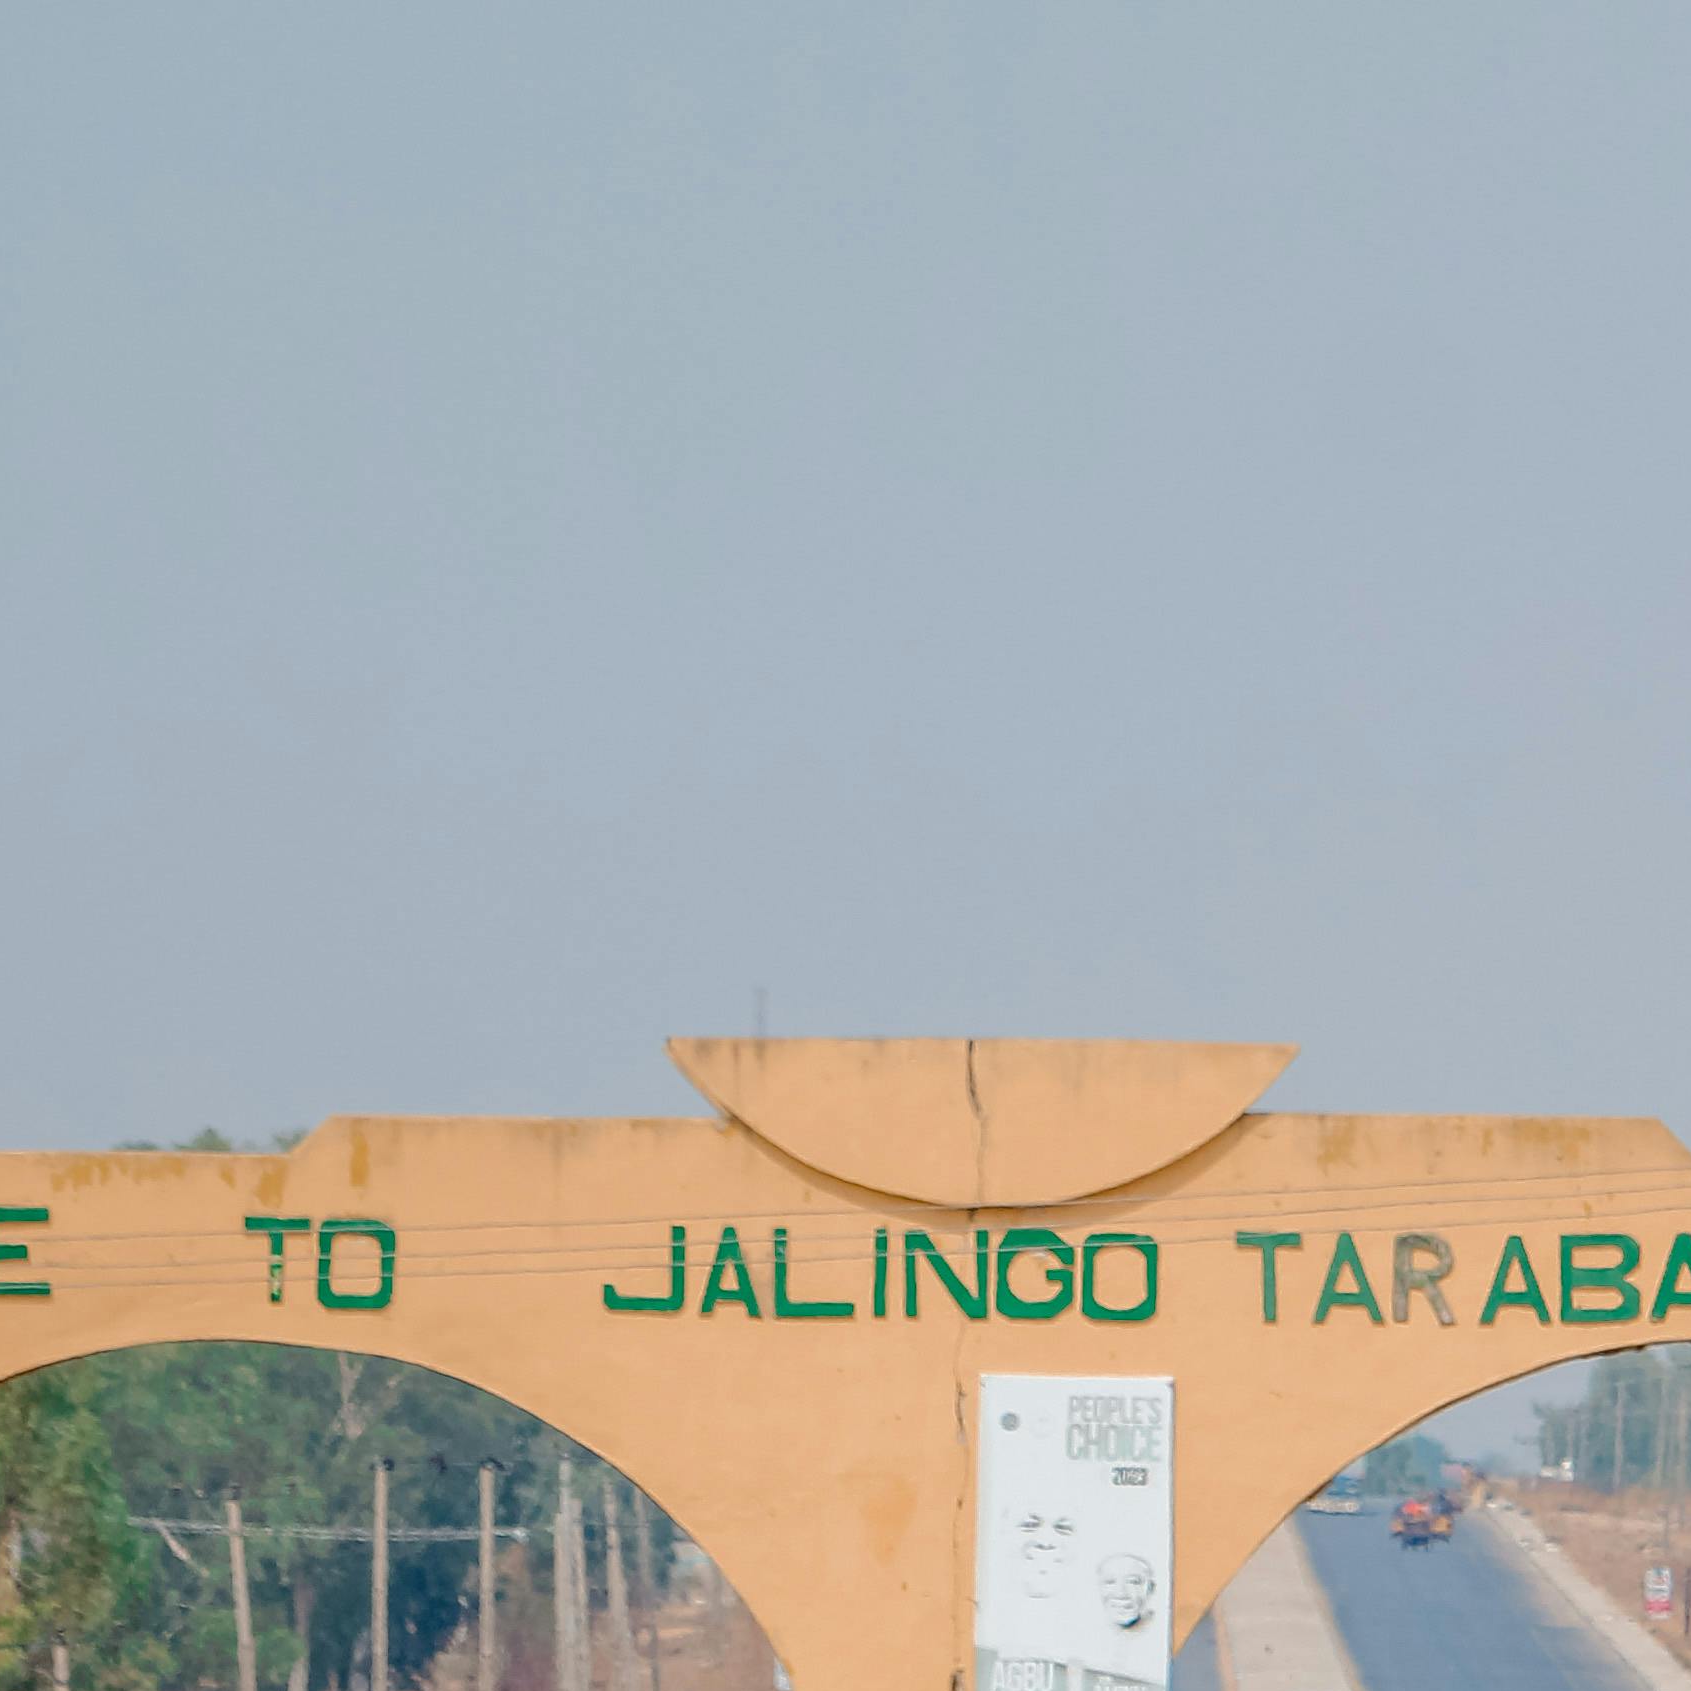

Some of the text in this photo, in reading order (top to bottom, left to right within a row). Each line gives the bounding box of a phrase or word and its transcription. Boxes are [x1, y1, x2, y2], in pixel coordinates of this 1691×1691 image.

[244, 1215, 397, 1310] TO
[602, 1225, 1159, 1322] JALINGO
[1066, 1425, 1162, 1461] CHOICE
[990, 1661, 1055, 1691] AGBU
